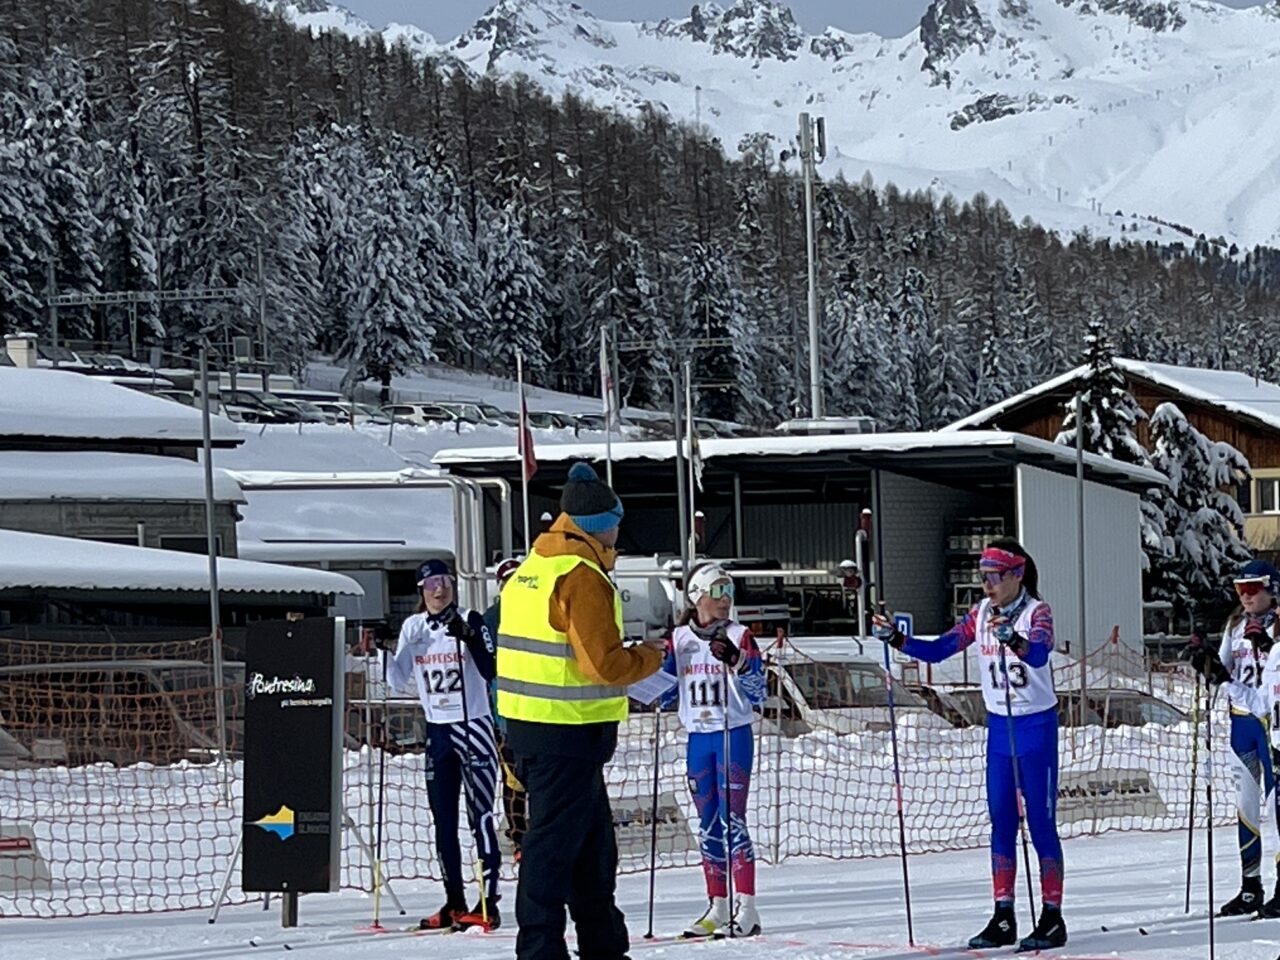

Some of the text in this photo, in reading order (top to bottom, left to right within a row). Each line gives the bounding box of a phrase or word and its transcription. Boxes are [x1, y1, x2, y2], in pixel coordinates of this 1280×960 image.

[250, 672, 315, 697] Pontresina
[423, 669, 462, 694] 122
[689, 681, 722, 708] 111
